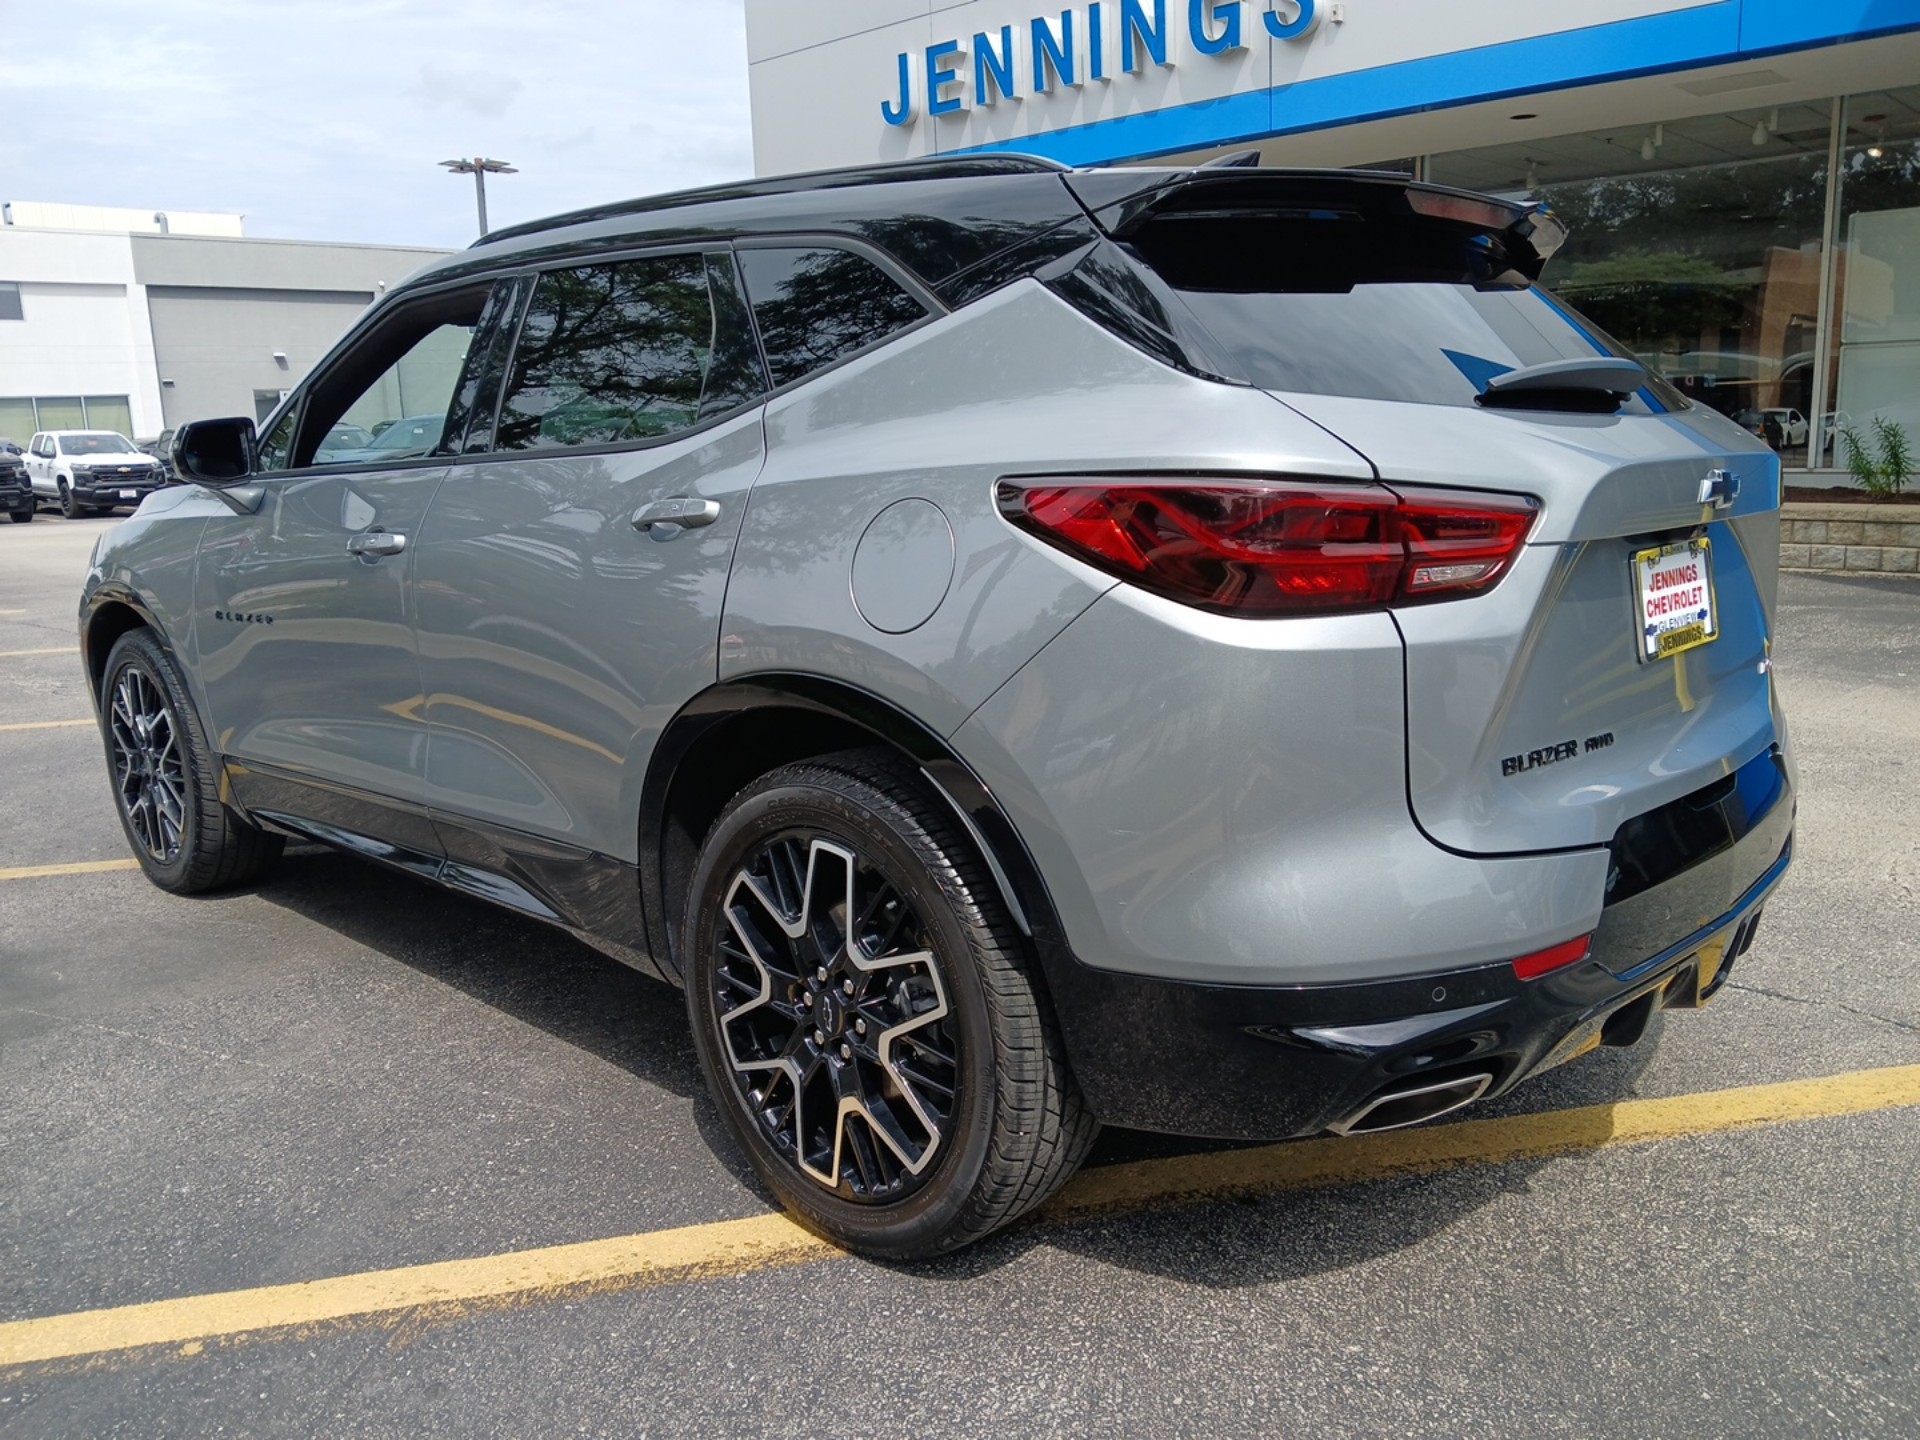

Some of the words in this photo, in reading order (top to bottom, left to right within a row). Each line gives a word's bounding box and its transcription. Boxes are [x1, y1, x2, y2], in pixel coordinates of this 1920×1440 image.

[1649, 563, 1698, 592] JENNINGS
[1646, 586, 1703, 618] CHEVROLET
[1658, 611, 1698, 633] GLENVIEW
[1661, 624, 1702, 652] JENNINGS
[1501, 739, 1578, 777] BLAZER
[1584, 732, 1614, 753] AWD
